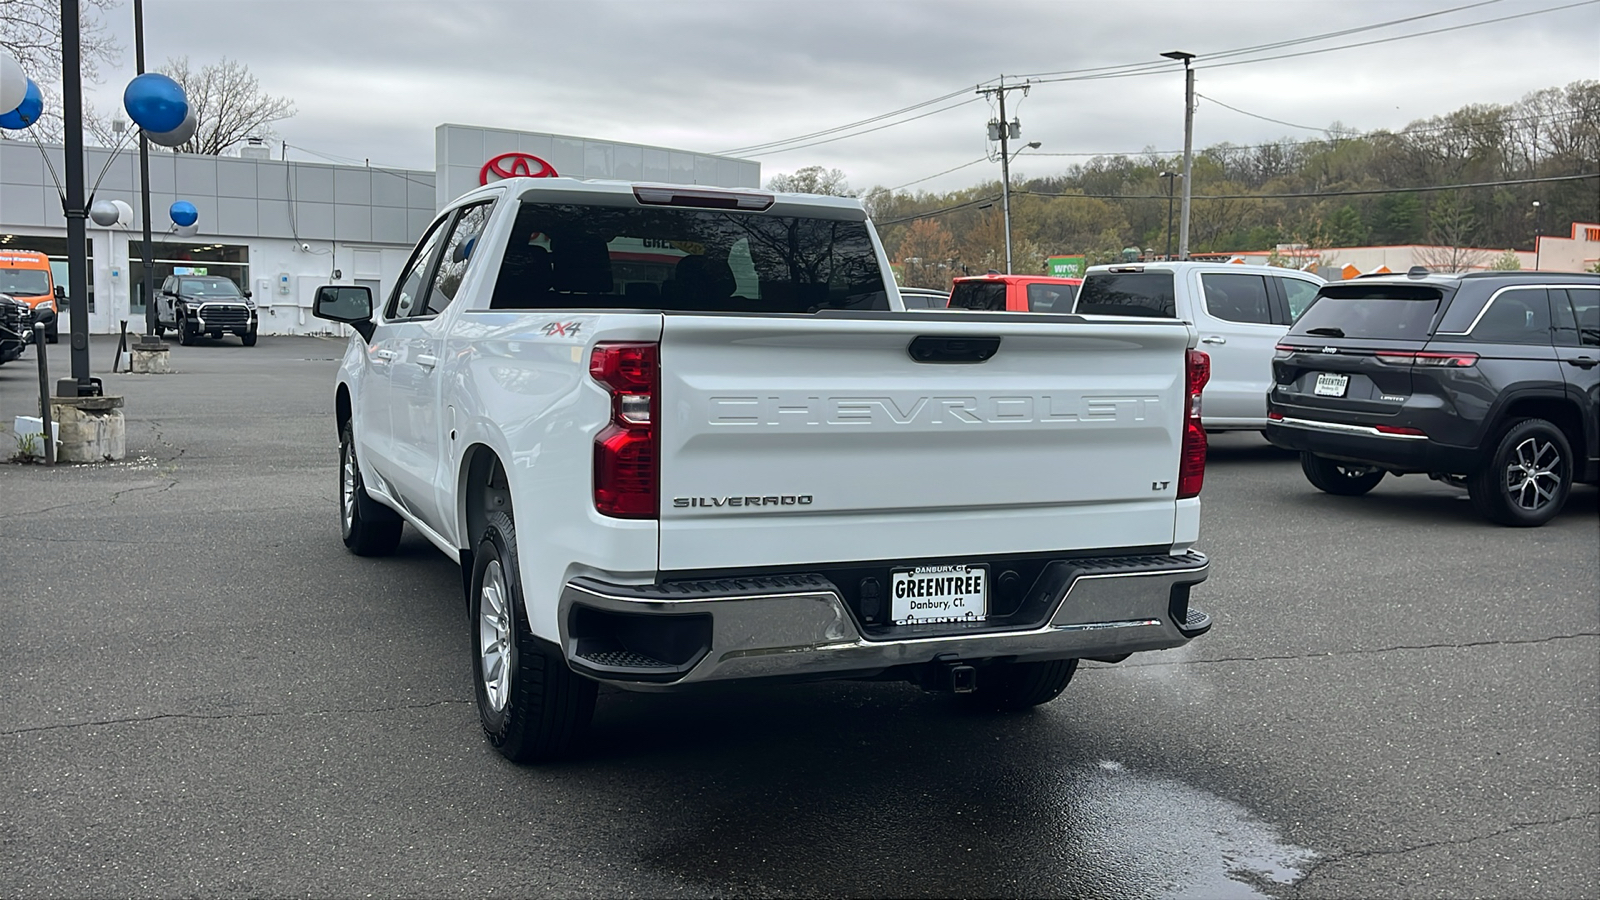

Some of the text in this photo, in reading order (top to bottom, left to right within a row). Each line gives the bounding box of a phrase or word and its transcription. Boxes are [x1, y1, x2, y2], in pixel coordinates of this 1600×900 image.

[1322, 346, 1337, 354] Jeep
[1318, 377, 1346, 387] GREENTREE
[707, 394, 1161, 426] CHEVROLET
[1151, 480, 1170, 491] LT
[672, 494, 814, 508] SILVERADO
[895, 576, 981, 599] GREENTREE
[910, 597, 965, 611] Danbury, CT.
[895, 615, 987, 626] GREENTREE
